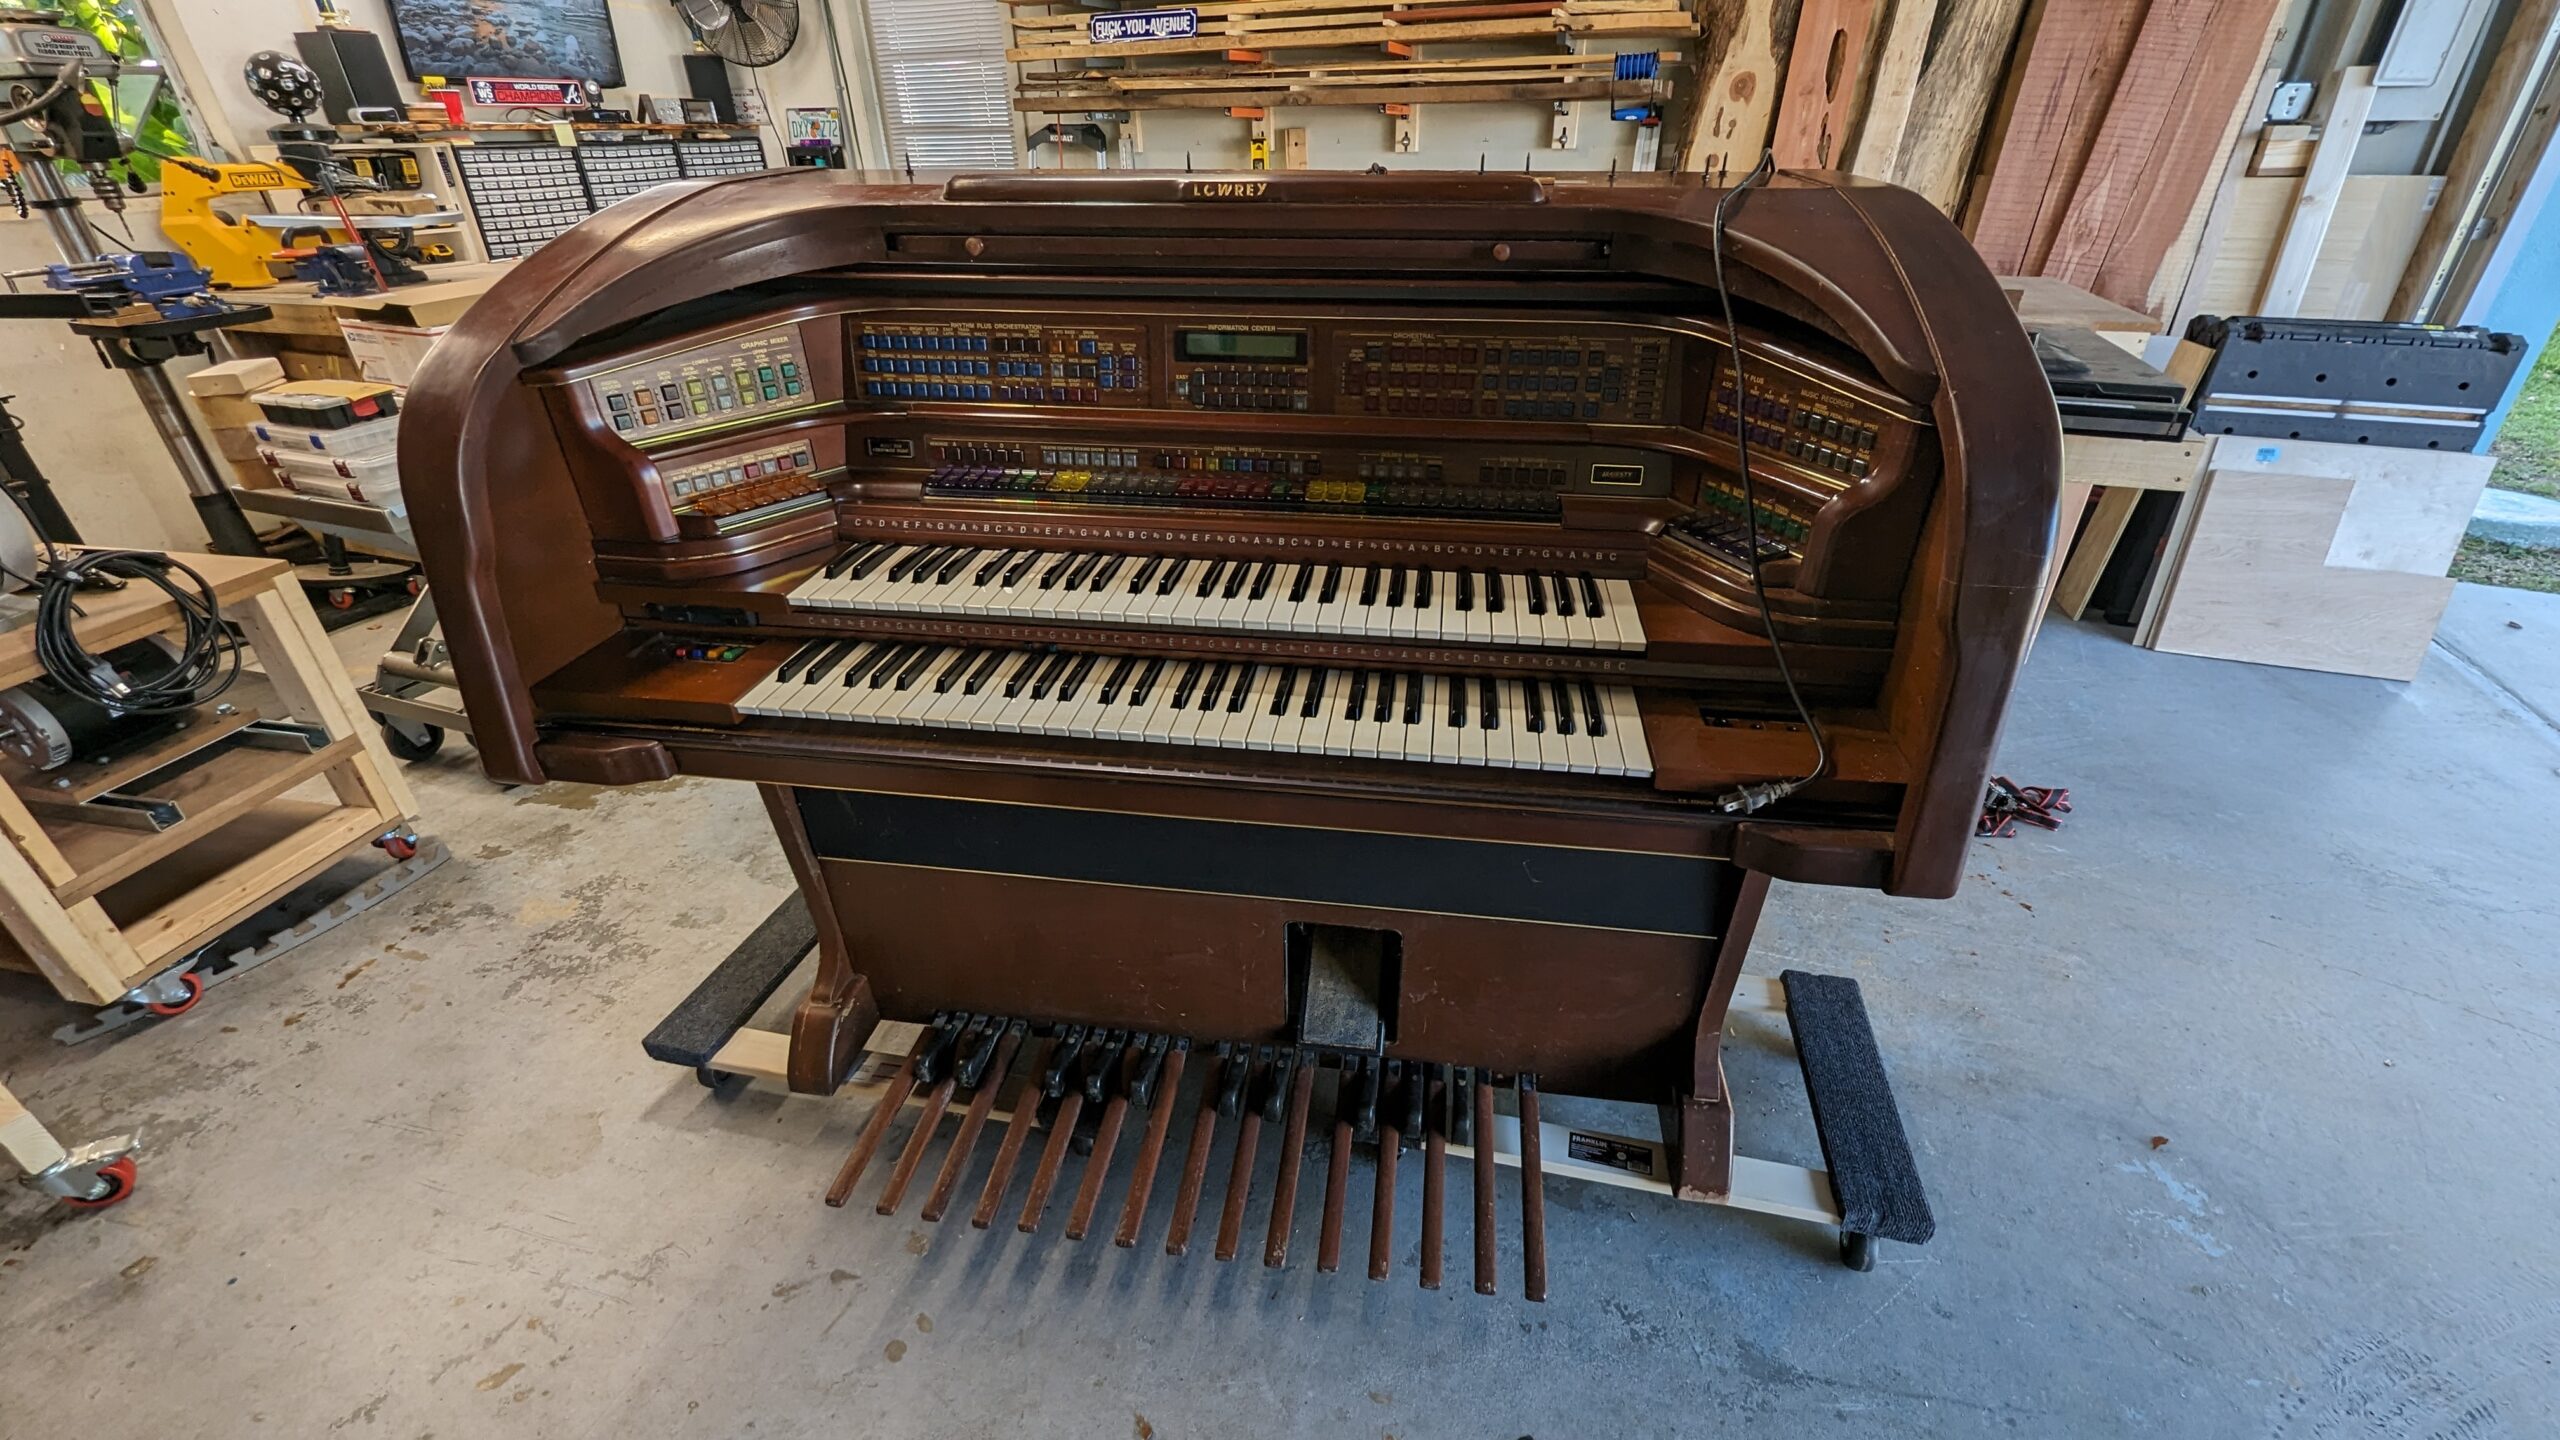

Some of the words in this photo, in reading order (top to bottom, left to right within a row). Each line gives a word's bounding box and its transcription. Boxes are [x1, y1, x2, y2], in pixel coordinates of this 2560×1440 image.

[1095, 16, 1191, 36] FUCK-YOU-AVENUE
[476, 88, 494, 98] WS
[496, 90, 564, 102] CHAMPIONS
[1050, 134, 1074, 142] KOALT
[231, 172, 282, 186] DeWALT
[1193, 183, 1267, 197] LOWREY
[741, 340, 768, 349] GRAPHIC
[770, 336, 789, 345] MIXER
[1821, 394, 1854, 409] RECORDER
[855, 518, 861, 526] C
[879, 519, 885, 527] D
[961, 523, 966, 531] A
[1141, 531, 1147, 539] C
[1166, 532, 1172, 540] D
[1229, 535, 1235, 543] G
[1254, 536, 1259, 544] A
[1291, 538, 1298, 546] C
[1318, 539, 1324, 547] D
[1448, 545, 1454, 553] C
[1503, 548, 1509, 556] E
[1596, 552, 1602, 560] B
[1572, 1135, 1608, 1148] FRANKLIN
